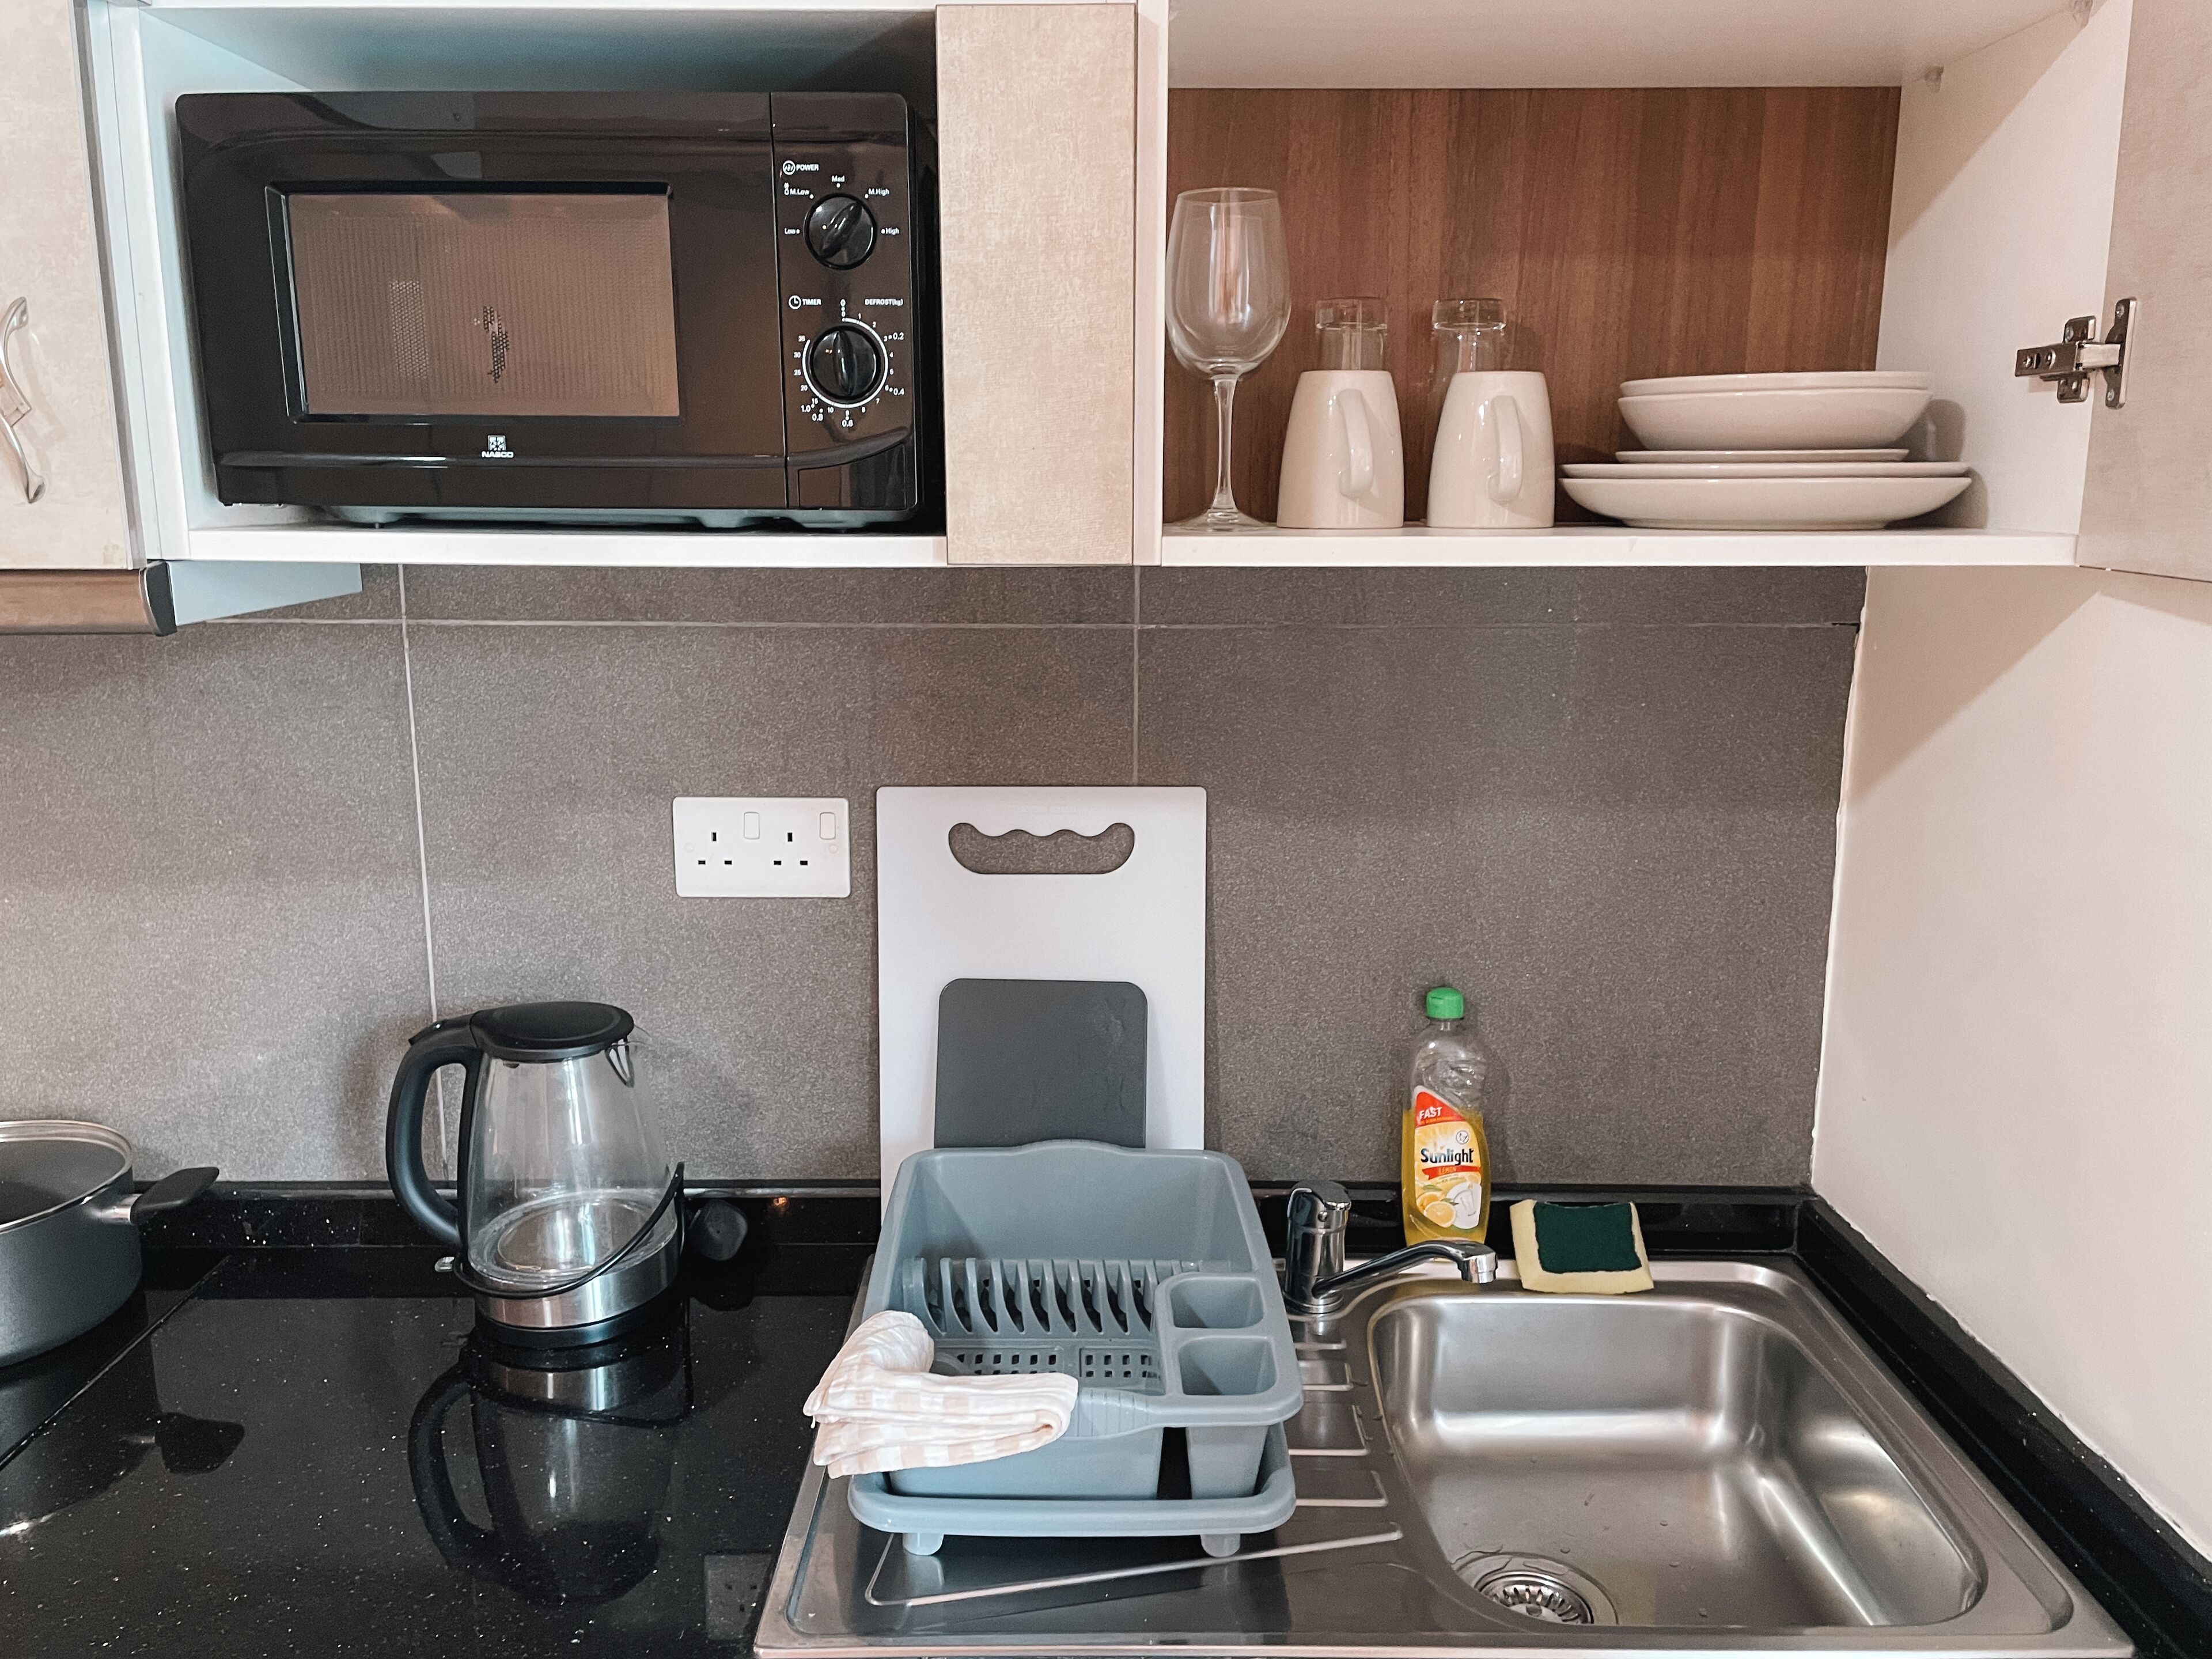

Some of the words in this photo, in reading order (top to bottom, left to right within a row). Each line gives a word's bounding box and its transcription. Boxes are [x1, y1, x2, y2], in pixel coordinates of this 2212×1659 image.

[865, 298, 904, 306] DEFROST(kg)
[892, 332, 904, 340] 0.2
[893, 388, 905, 396] 0.4
[801, 404, 811, 412] 1.0
[1418, 1106, 1442, 1120] FAST
[1421, 1148, 1474, 1166] Sunlight
